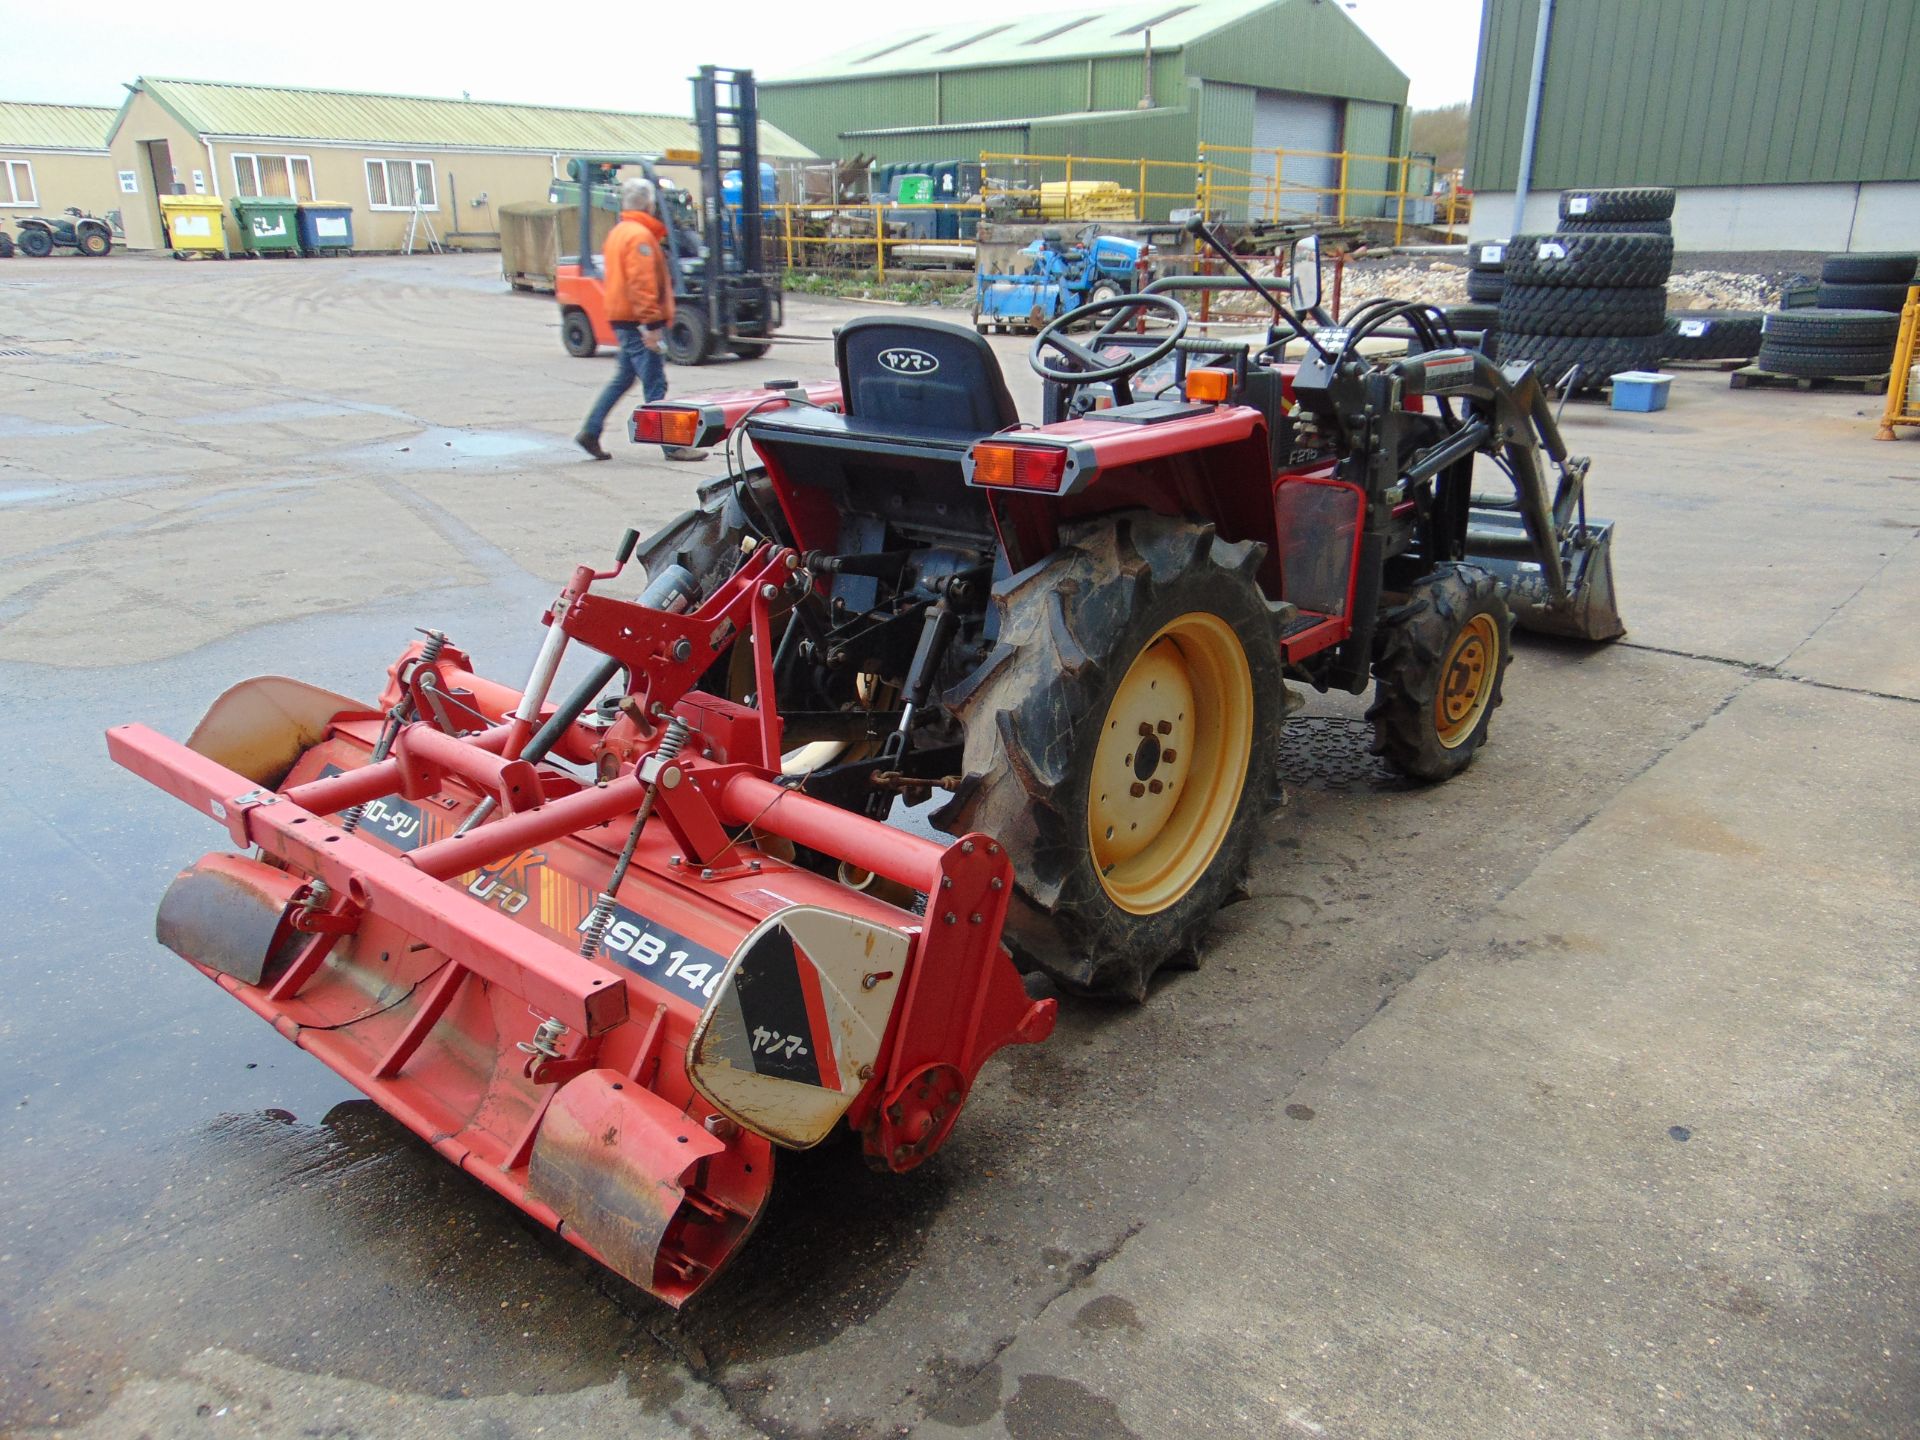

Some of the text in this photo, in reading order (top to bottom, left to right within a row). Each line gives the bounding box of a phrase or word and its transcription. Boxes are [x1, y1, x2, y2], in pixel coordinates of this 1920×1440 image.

[886, 352, 931, 370] ヤンマー
[468, 874, 529, 913] UFO
[752, 1025, 808, 1060] ヤンマー
